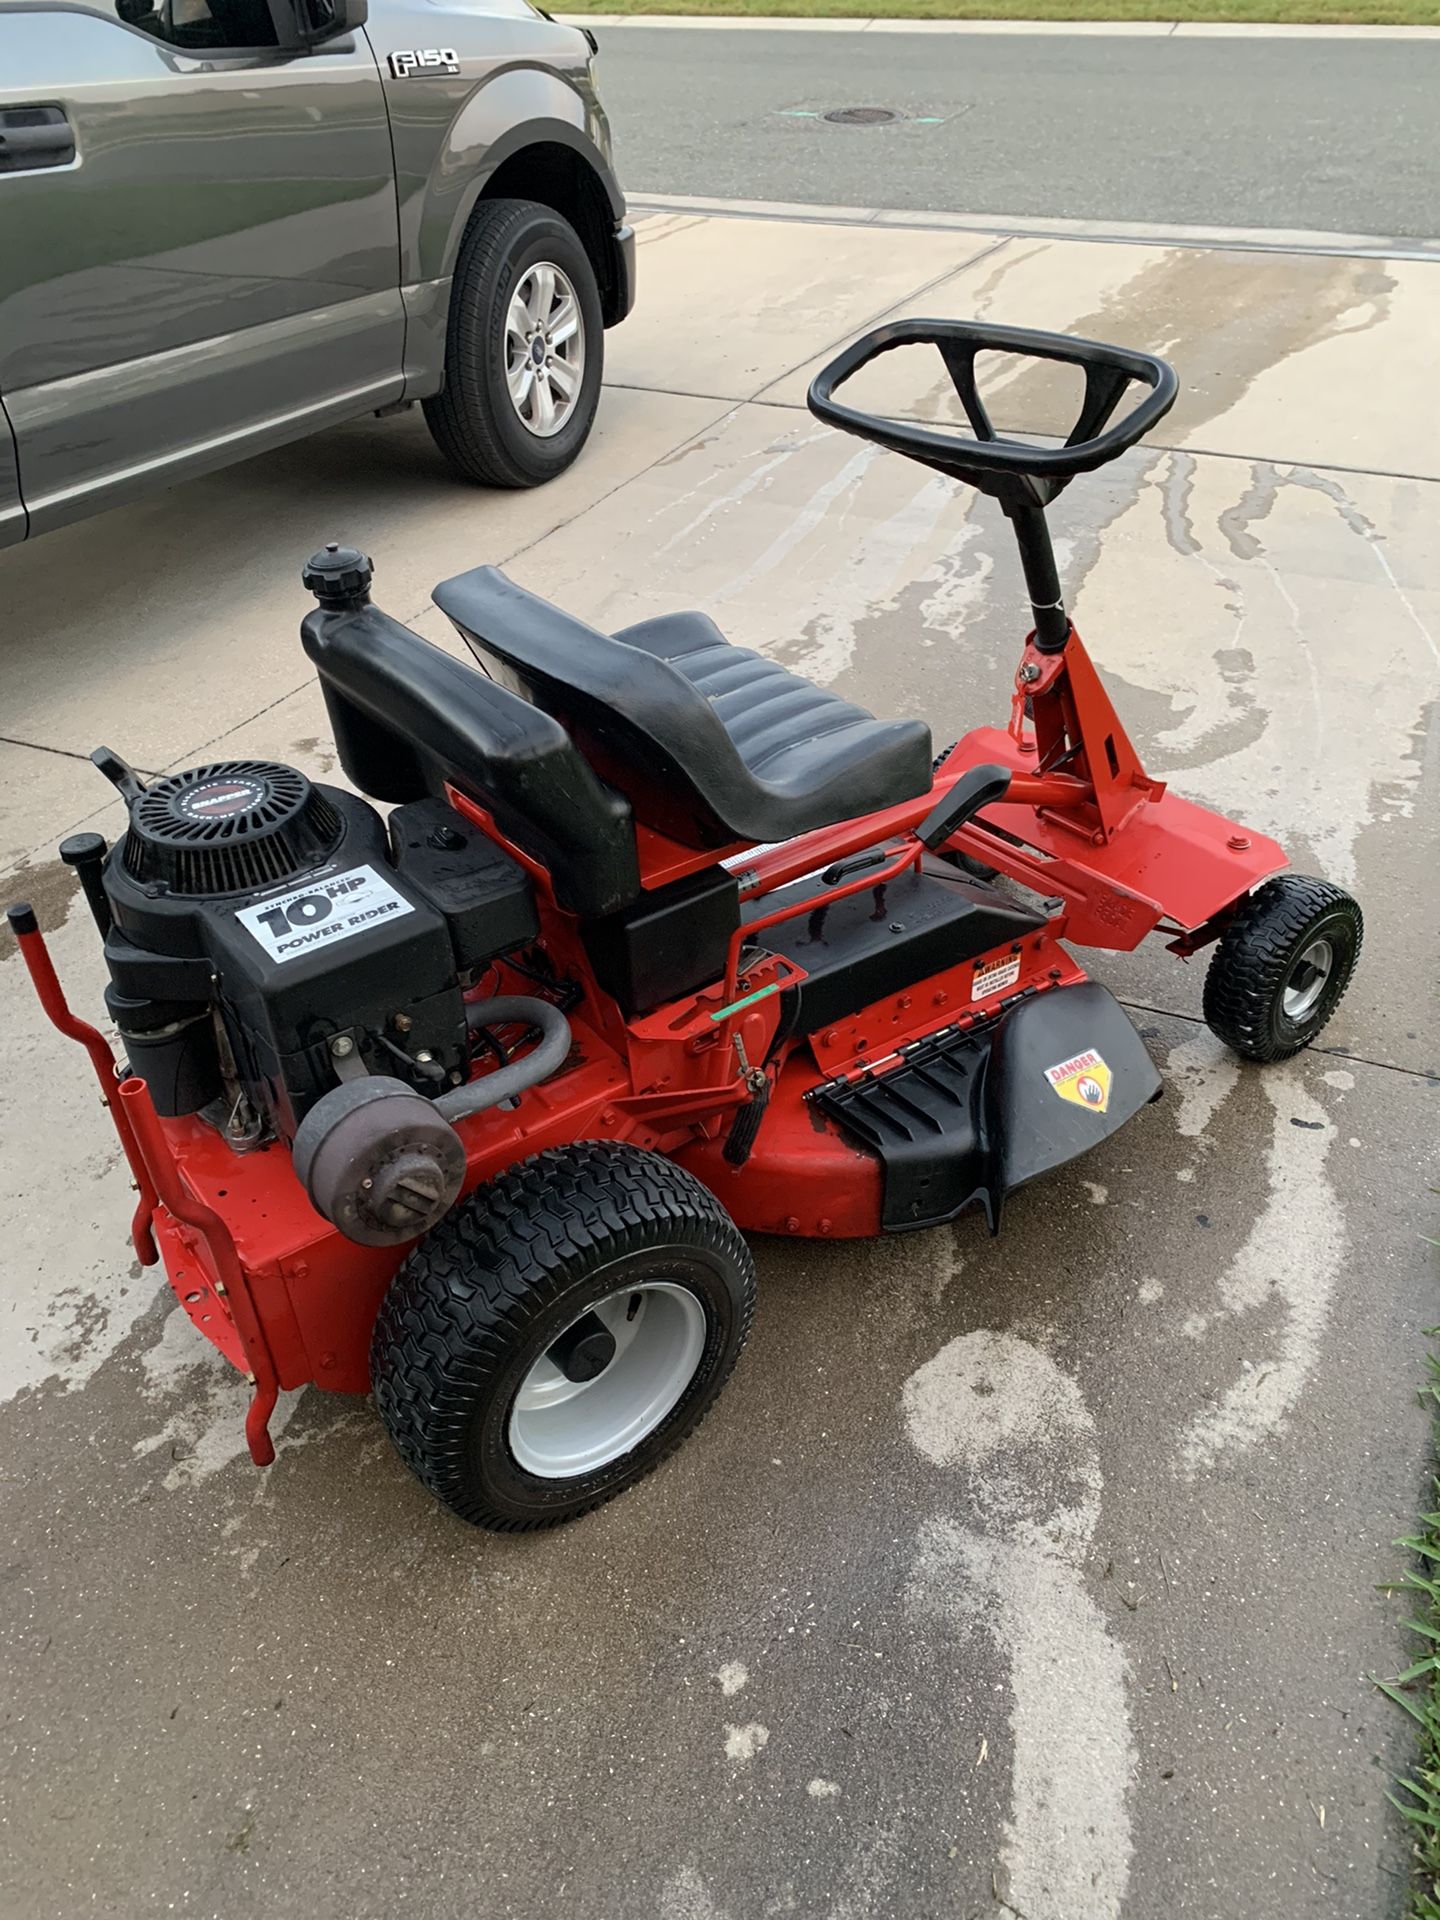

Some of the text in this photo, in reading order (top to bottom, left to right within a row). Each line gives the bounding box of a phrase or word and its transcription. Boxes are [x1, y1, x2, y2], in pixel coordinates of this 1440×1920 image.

[387, 48, 460, 79] F150
[256, 894, 333, 938] 10
[325, 877, 367, 900] HP
[277, 922, 344, 954] POWER
[348, 901, 400, 927] RIDER
[1050, 1053, 1097, 1082] DANGER
